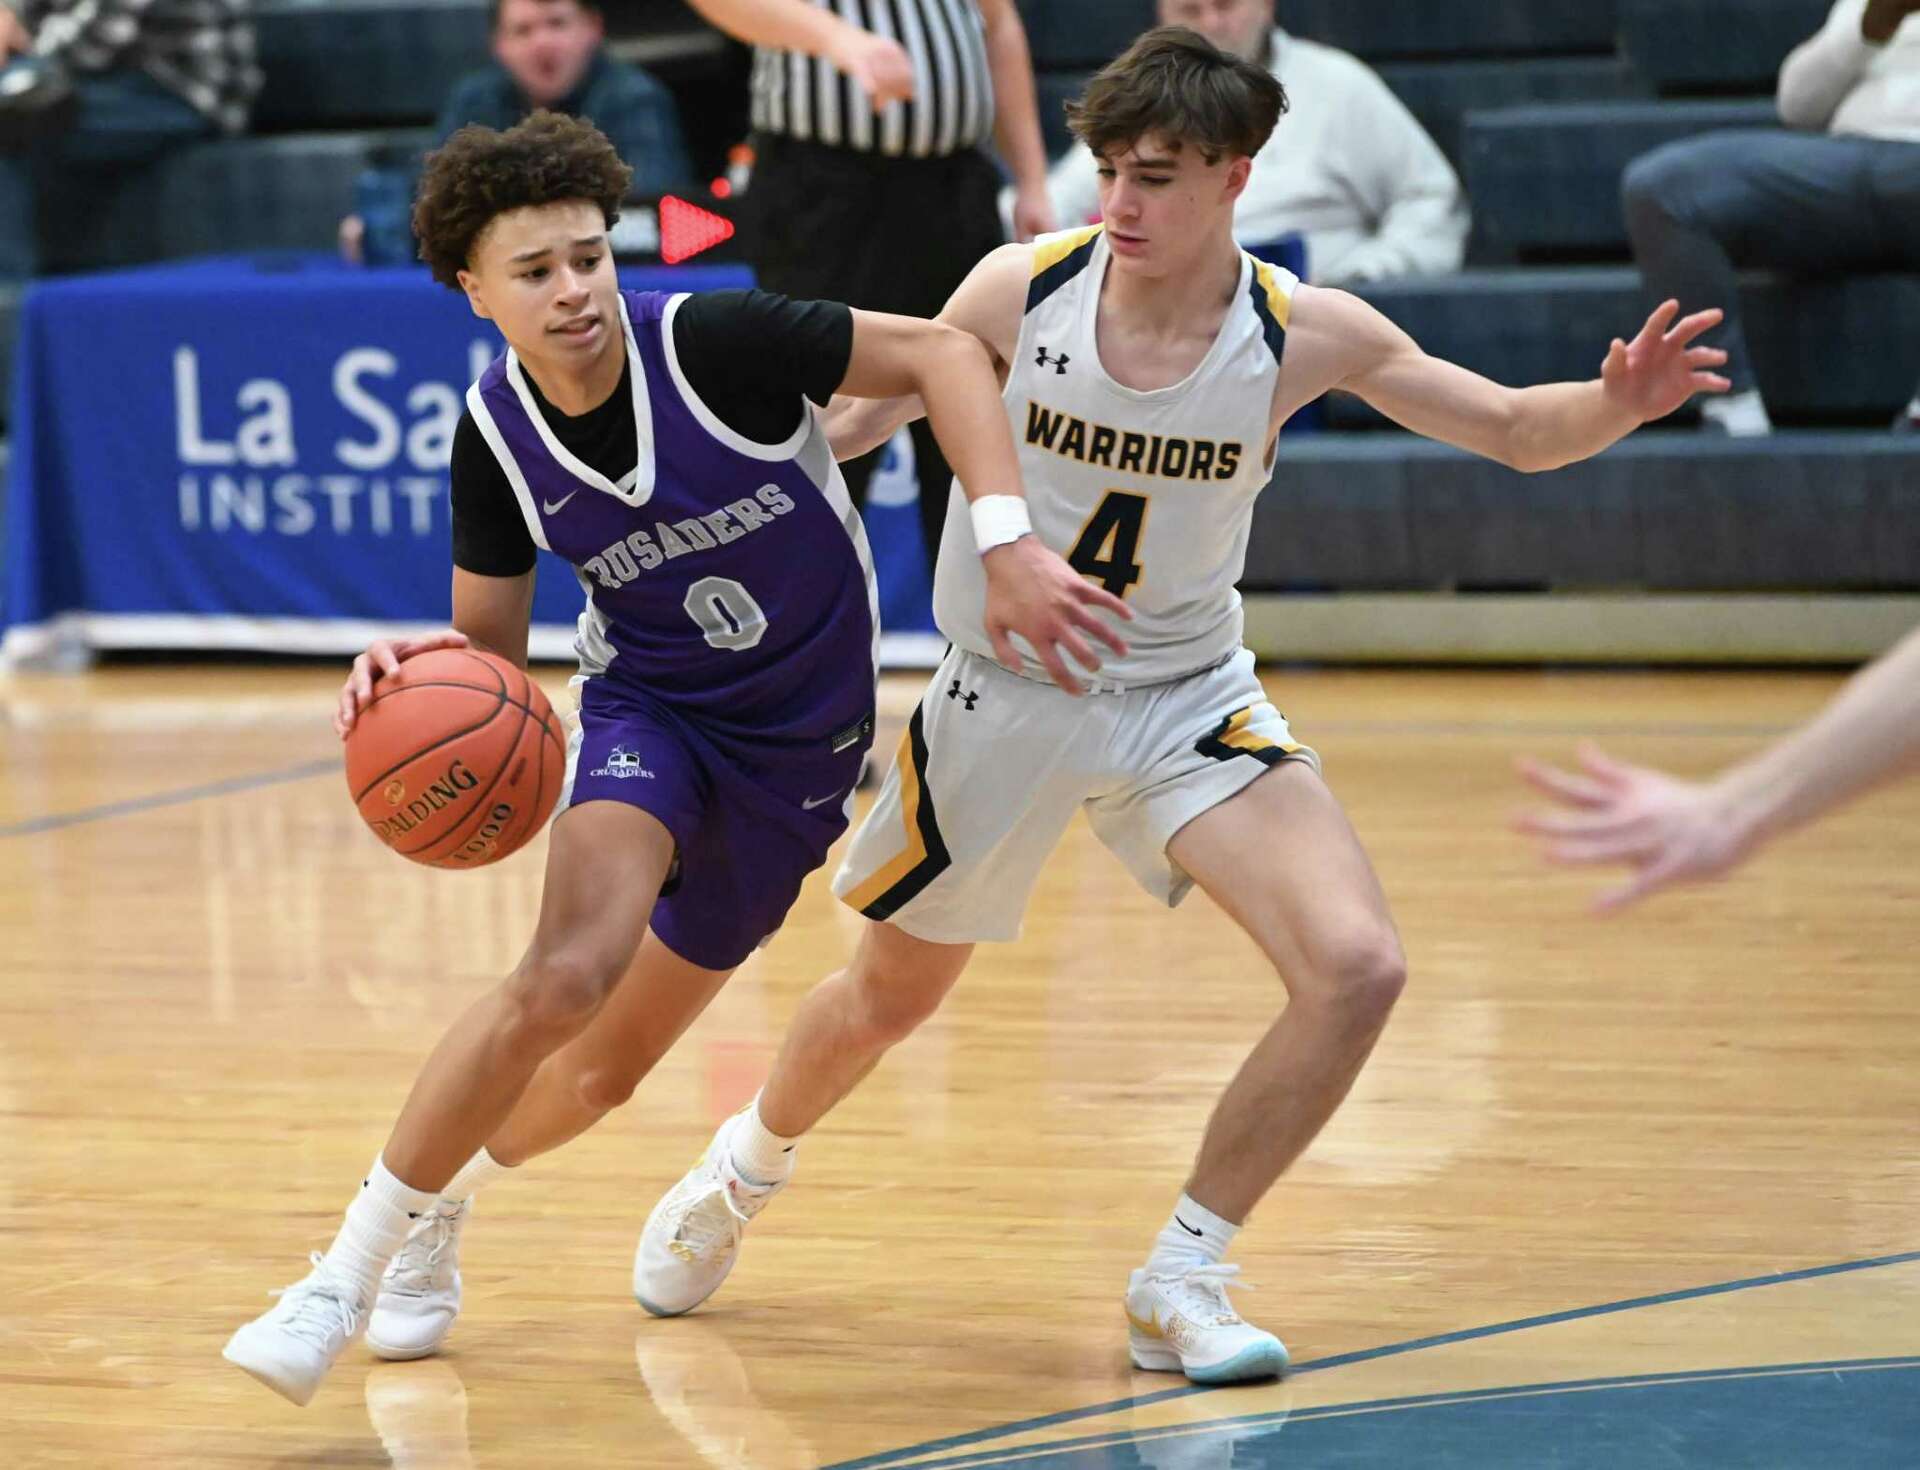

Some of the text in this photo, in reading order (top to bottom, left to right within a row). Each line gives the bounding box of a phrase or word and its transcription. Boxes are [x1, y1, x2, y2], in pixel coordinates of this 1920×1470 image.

[173, 346, 296, 467] La
[1025, 400, 1242, 481] WARRIORS
[1064, 488, 1151, 600] 4
[683, 576, 769, 652] 0
[590, 766, 656, 779] CRUSADERS
